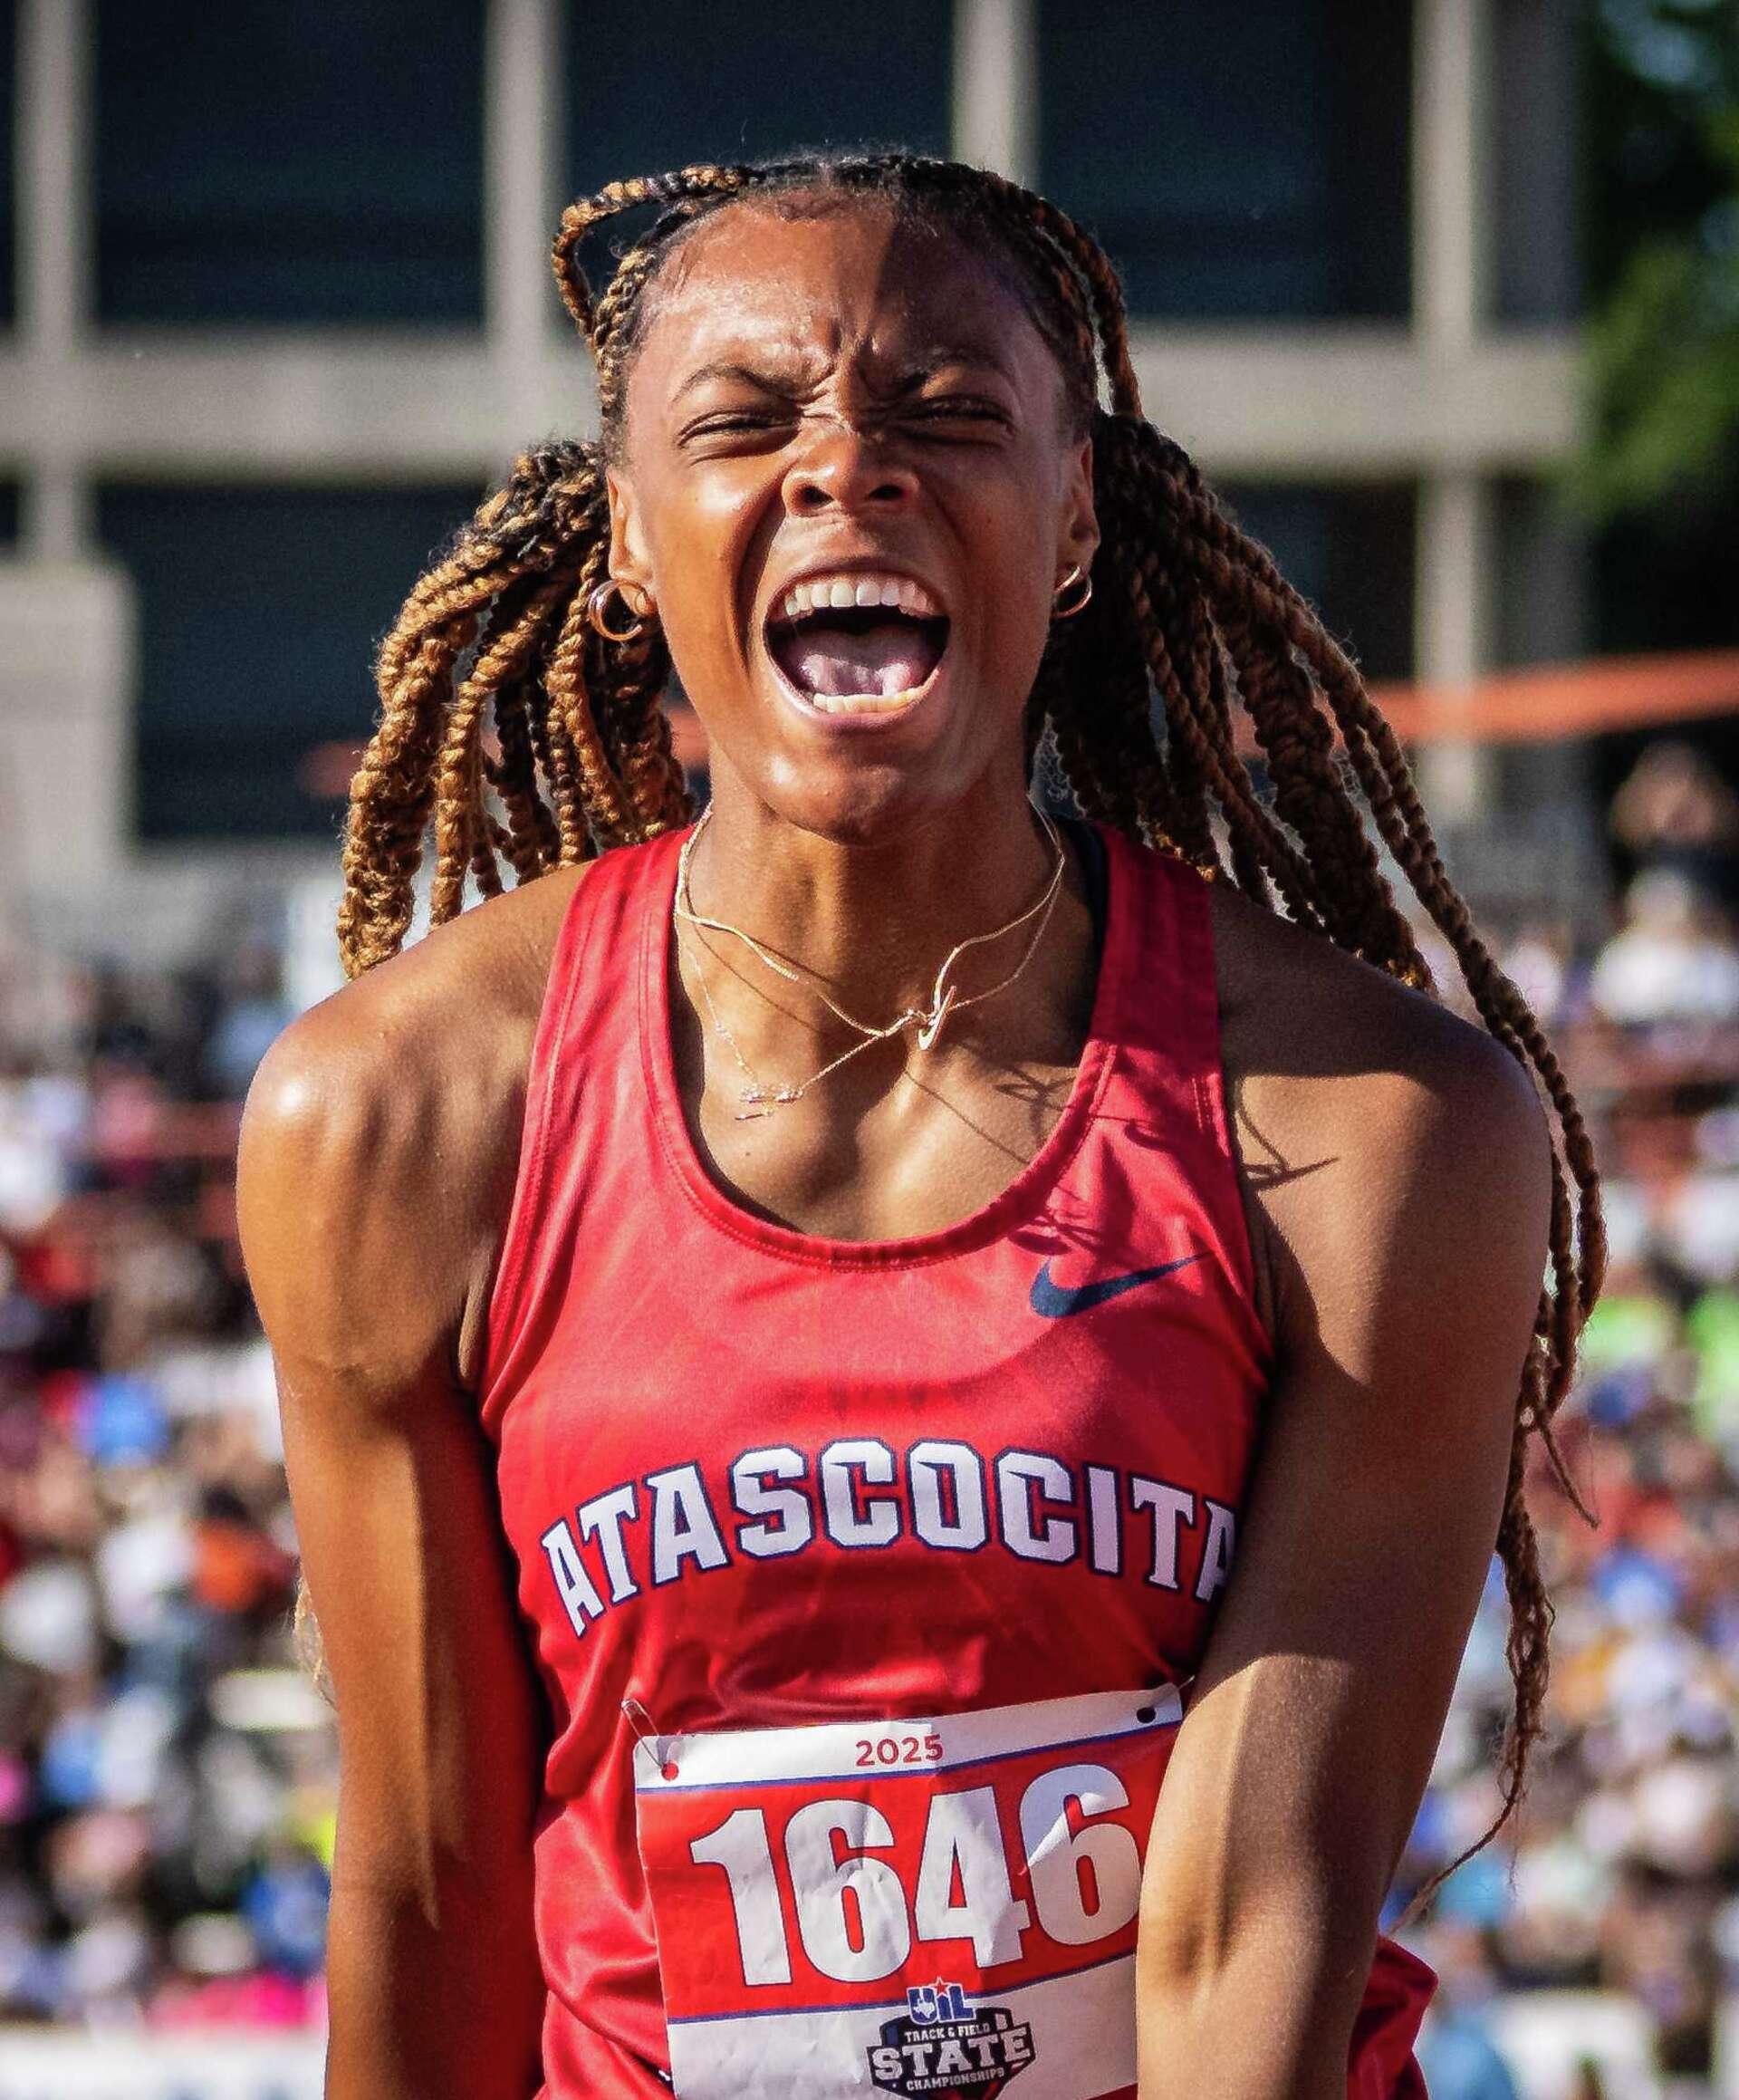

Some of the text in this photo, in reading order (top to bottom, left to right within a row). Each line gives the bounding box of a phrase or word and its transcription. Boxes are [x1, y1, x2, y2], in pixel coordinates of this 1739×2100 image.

[541, 1439, 1235, 1639] ATASCOCITA
[855, 1735, 944, 1767] 2025
[689, 1763, 1142, 1987] 1646
[871, 2027, 1031, 2081] STATE
[905, 2023, 991, 2043] TRACK & FIELD
[907, 2067, 1004, 2091] CHAMPIONSHIPS
